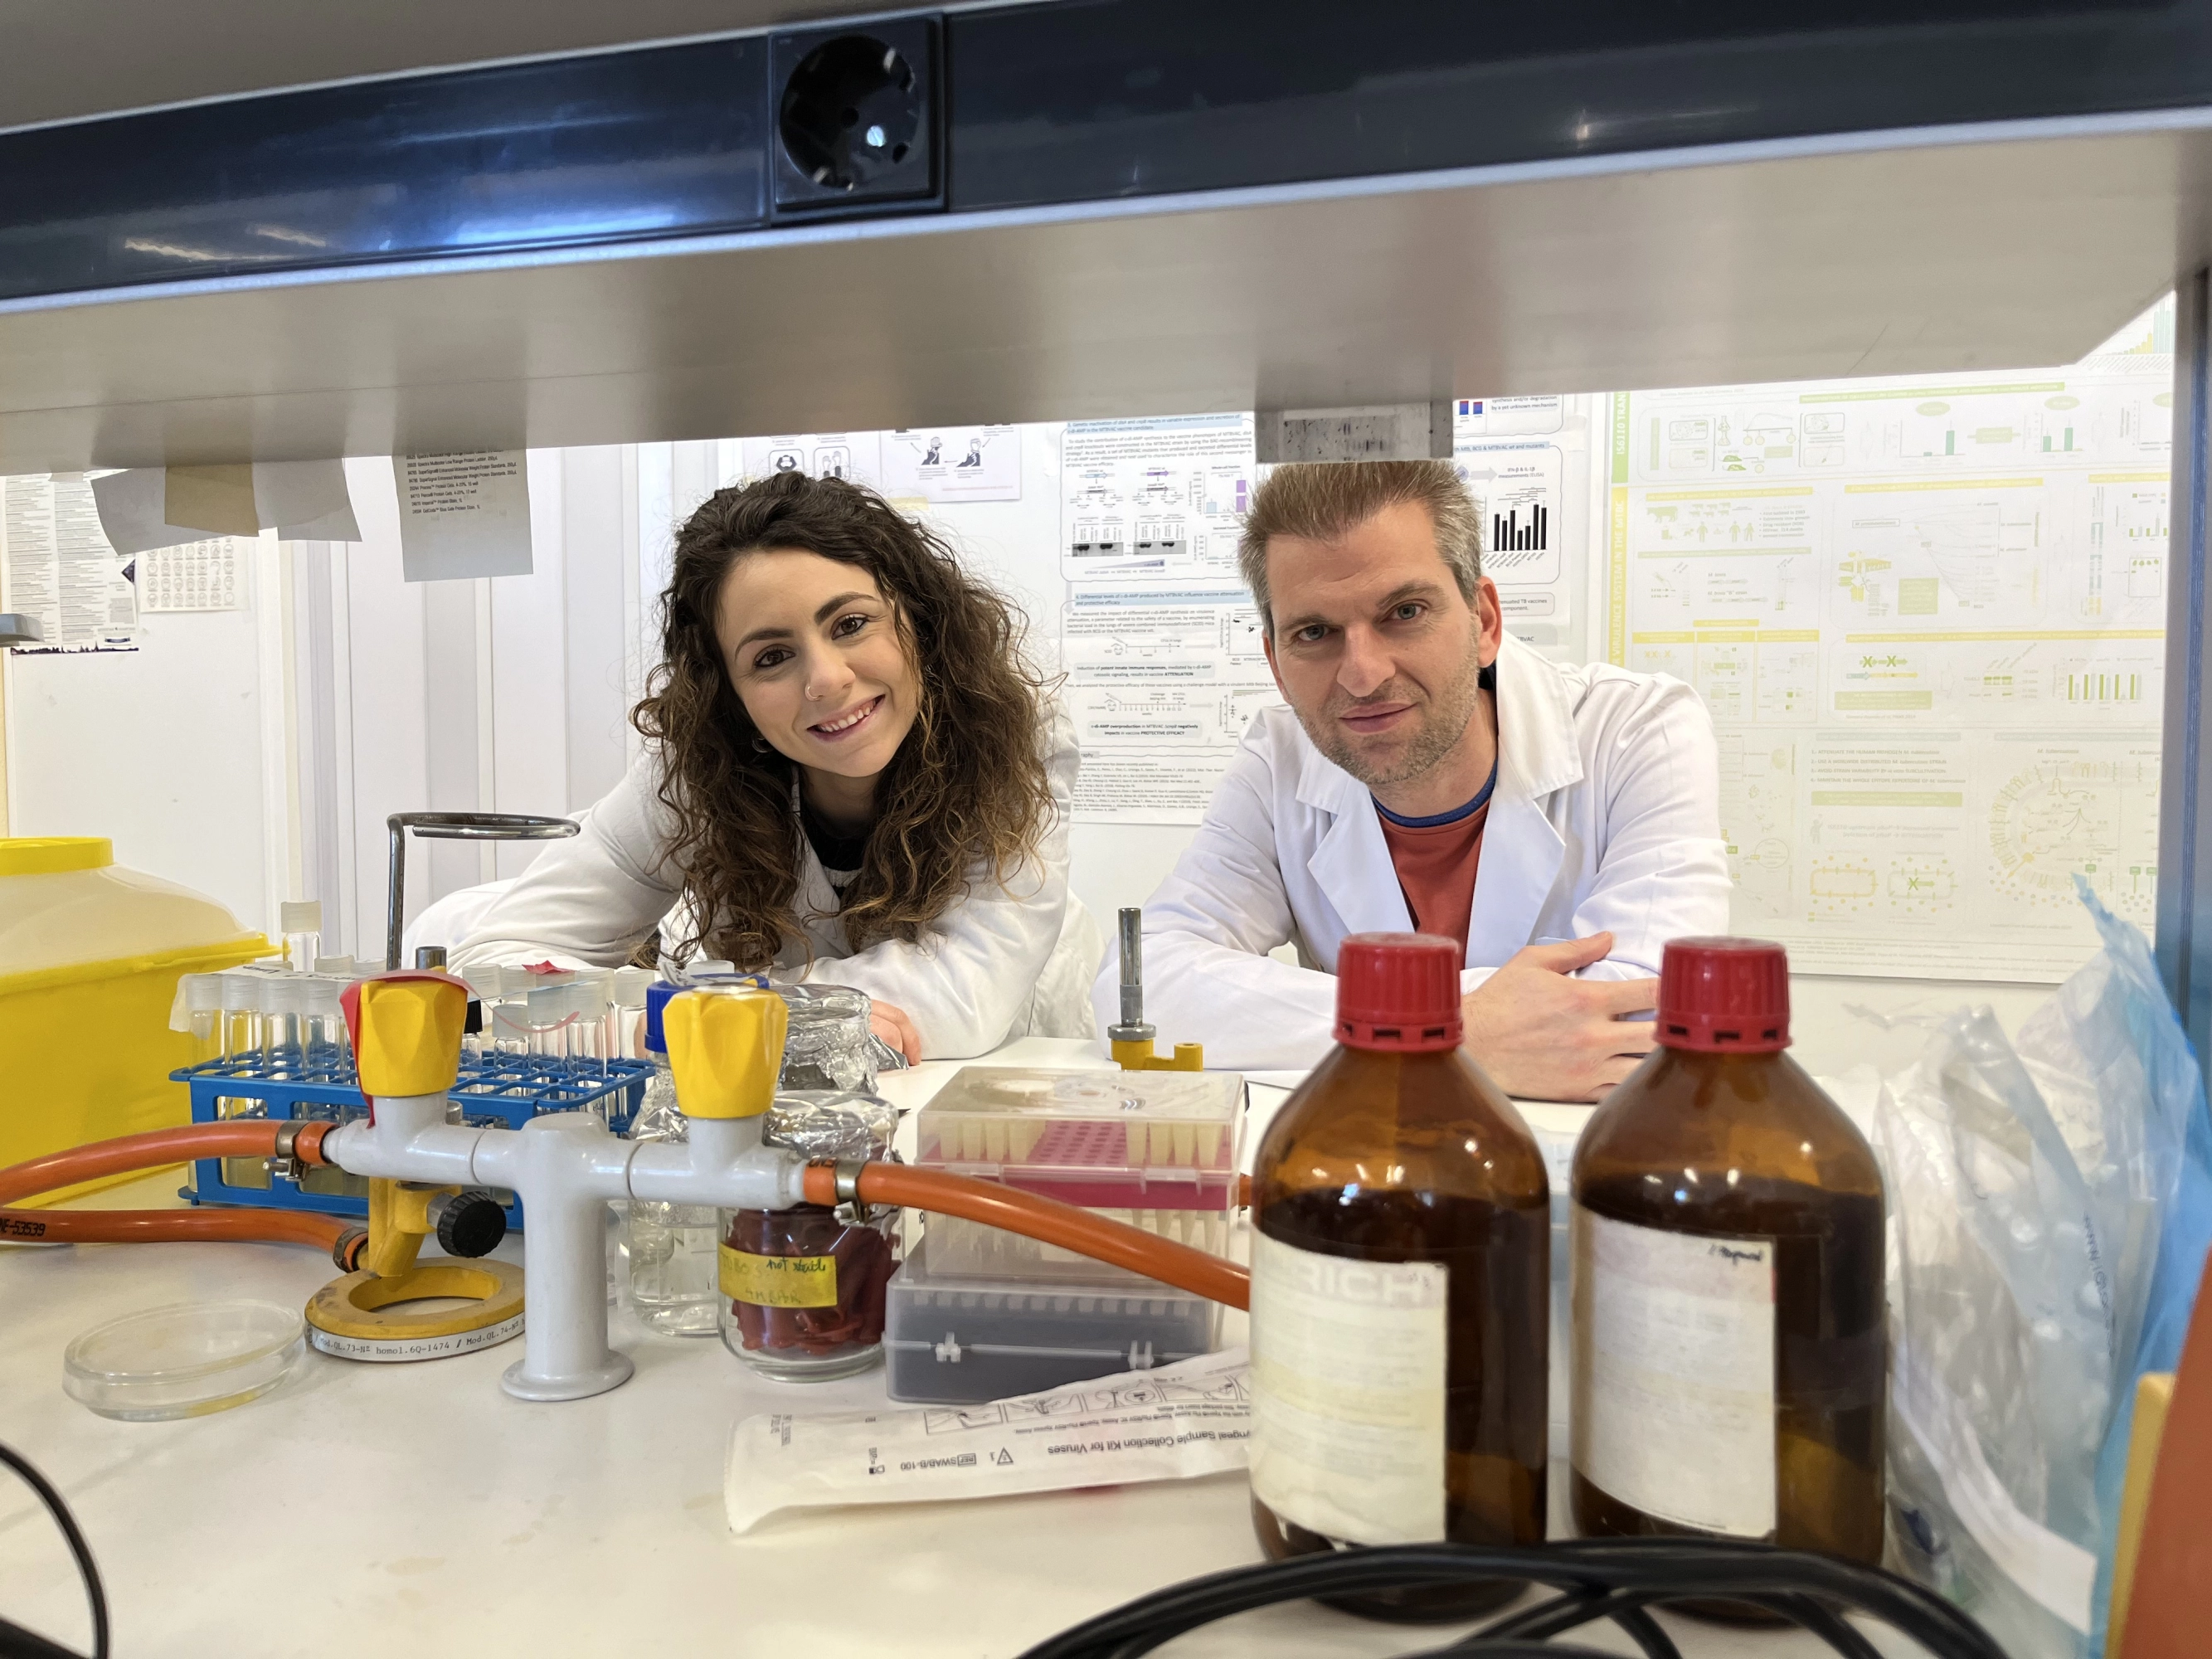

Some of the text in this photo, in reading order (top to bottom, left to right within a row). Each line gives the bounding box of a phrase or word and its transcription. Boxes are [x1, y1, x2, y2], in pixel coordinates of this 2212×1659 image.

[1124, 1435, 1174, 1447] Collection
[1177, 1430, 1216, 1443] Sample
[1048, 1444, 1087, 1455] Viruses
[1091, 1442, 1105, 1451] for
[1107, 1440, 1121, 1450] Kit
